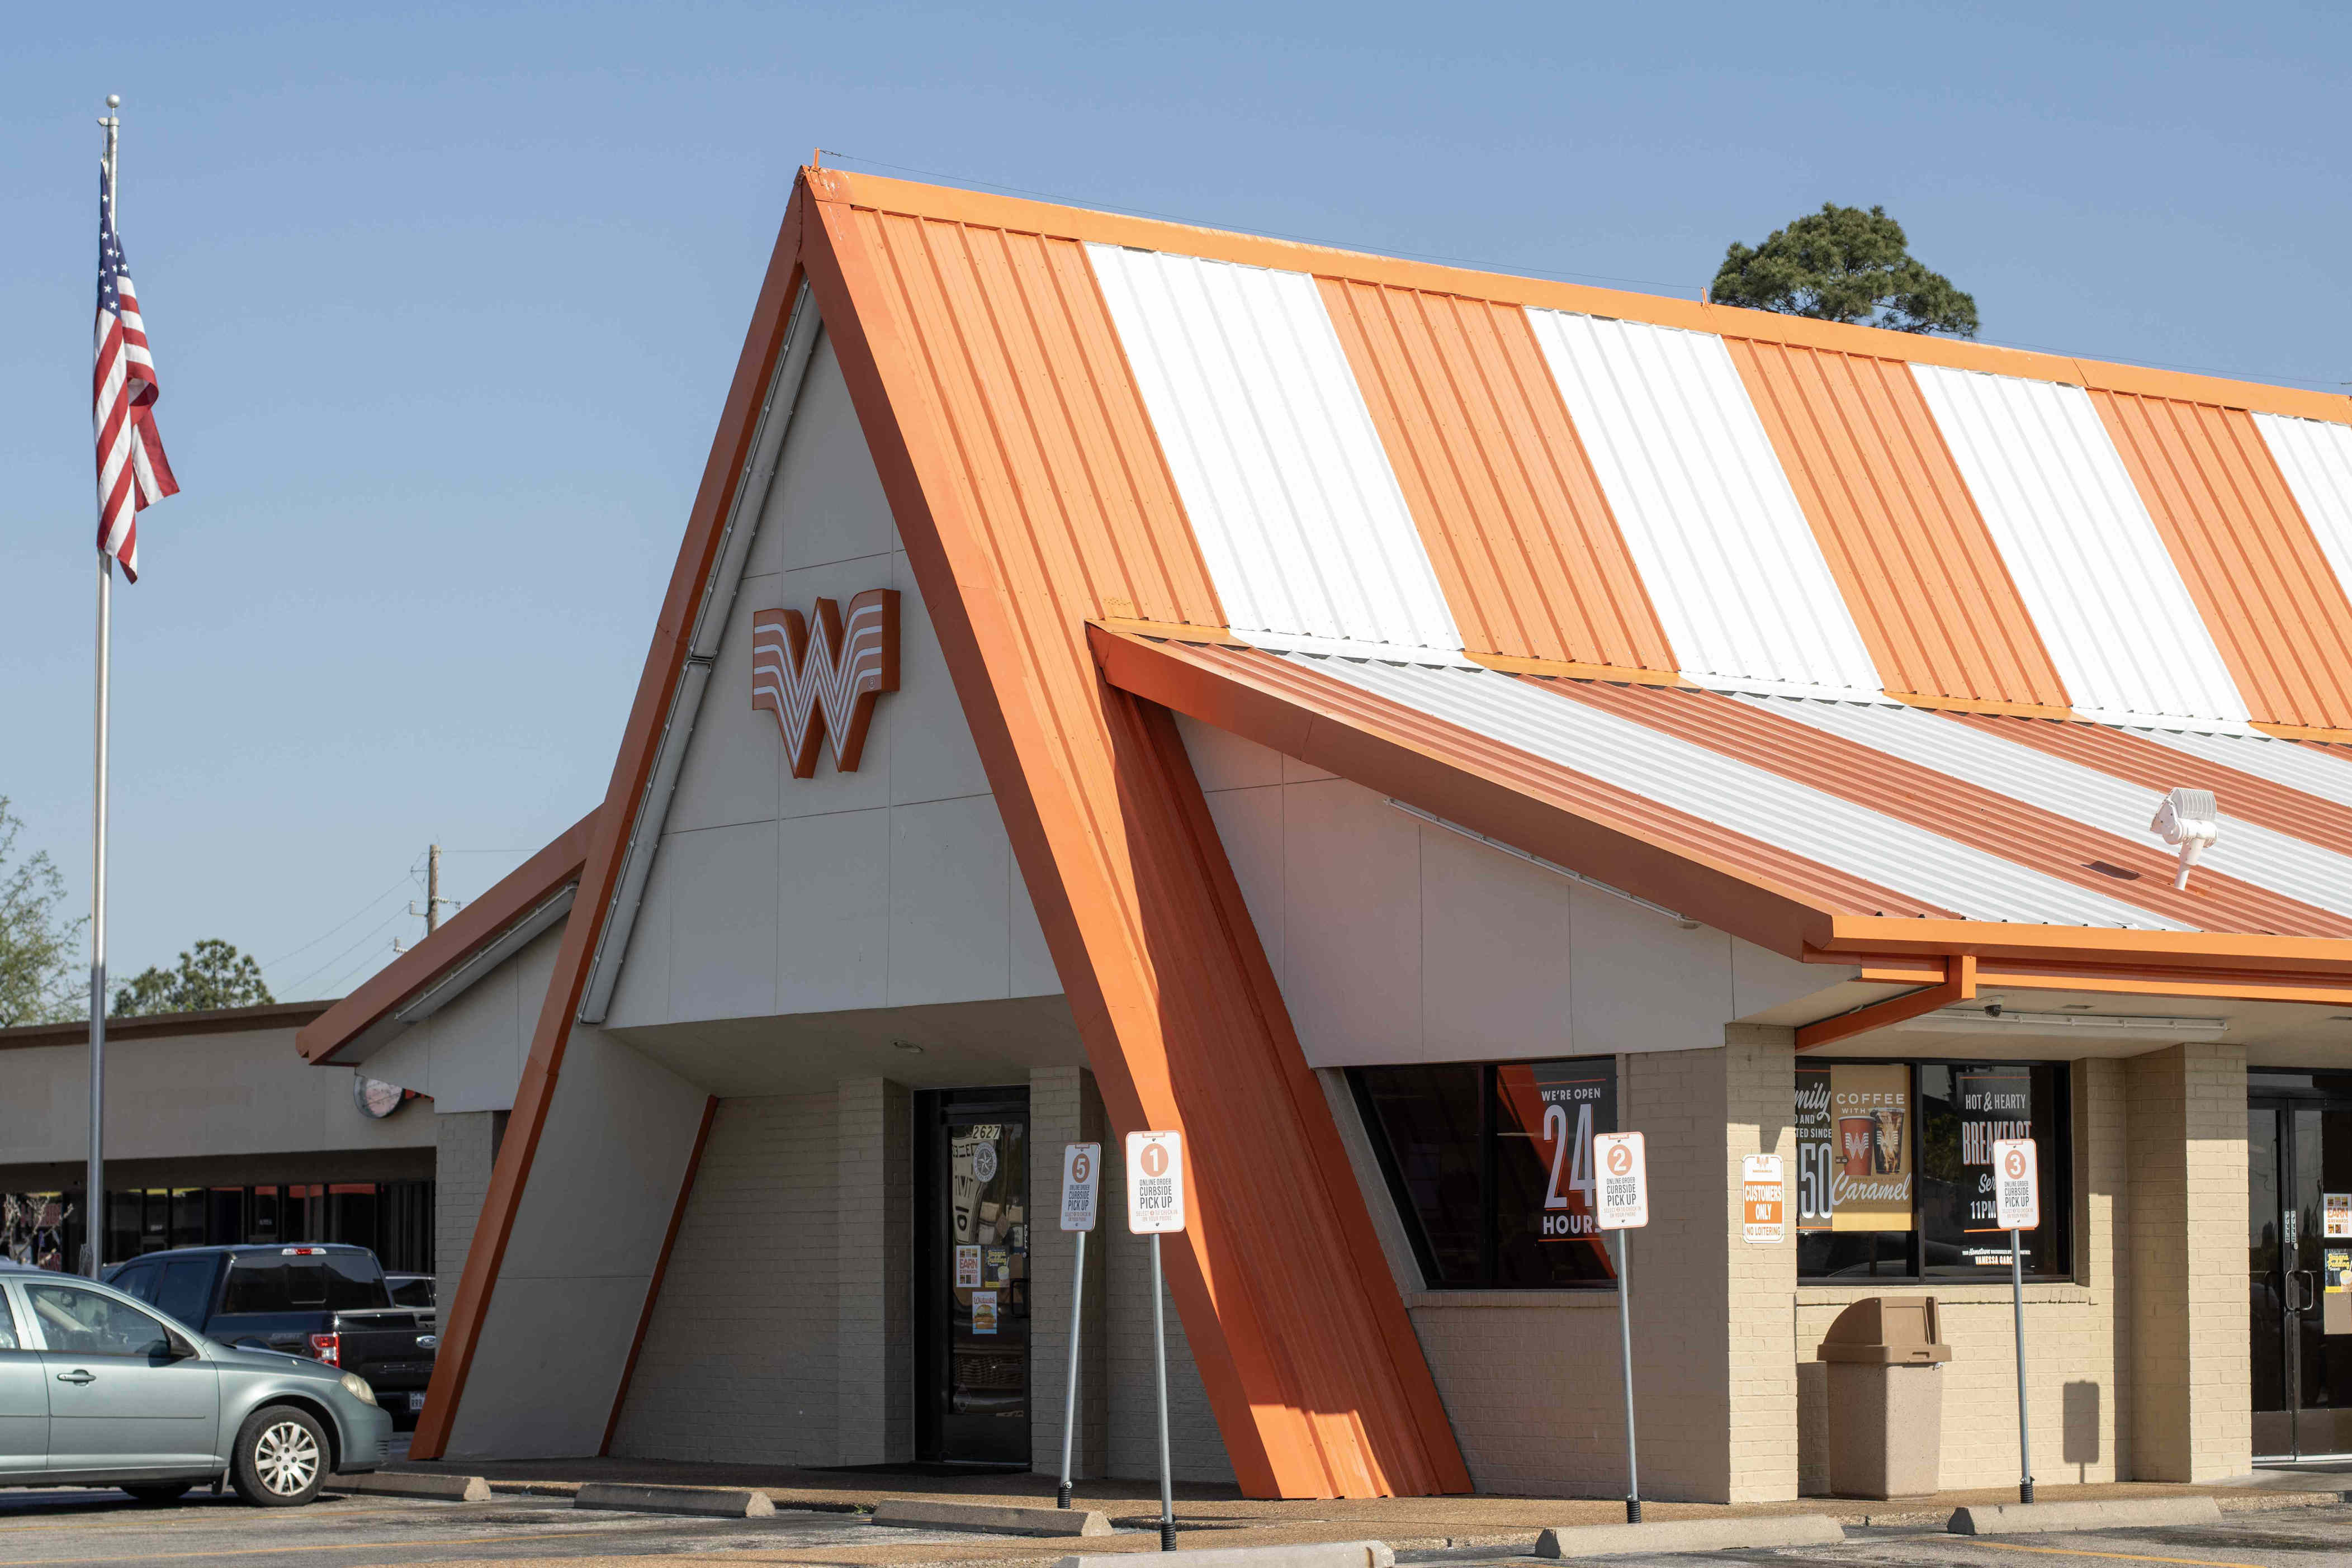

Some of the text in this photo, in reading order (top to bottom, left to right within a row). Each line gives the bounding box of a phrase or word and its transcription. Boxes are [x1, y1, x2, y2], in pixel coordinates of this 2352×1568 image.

[753, 589, 901, 778] W
[1541, 1088, 1601, 1101] WE'RE OPEN
[1836, 1093, 1905, 1105] COFFEE
[1965, 1092, 2026, 1112] HOT & HEARTY
[1800, 1114, 1815, 1124] AND
[973, 1126, 1000, 1139] 2627
[1811, 1128, 1832, 1138] SINCE
[1149, 1148, 1158, 1172] 1
[1544, 1103, 1596, 1210] 24
[1613, 1149, 1627, 1171] 2
[1076, 1158, 1086, 1179] 5
[2010, 1154, 2021, 1175] 3
[1140, 1186, 1172, 1196] CURBSIDE
[1607, 1184, 1636, 1194] CURBSIDE
[1745, 1185, 1782, 1201] CUSTOMERS
[1832, 1170, 1911, 1205] Caramel
[2005, 1187, 2029, 1196] CURBSIDE
[1069, 1191, 1090, 1200] CURBSIDE
[1607, 1193, 1636, 1206] PICK UP
[2005, 1196, 2029, 1207] PICK UP
[1068, 1200, 1089, 1211] PICK UP
[1140, 1196, 1172, 1209] PICK UP
[1755, 1204, 1772, 1220] ONLY
[2327, 1207, 2348, 1218] EARN
[1747, 1226, 1781, 1235] NO LOITERING
[959, 1258, 977, 1269] EARN
[1975, 1256, 1999, 1265] VANESSA
